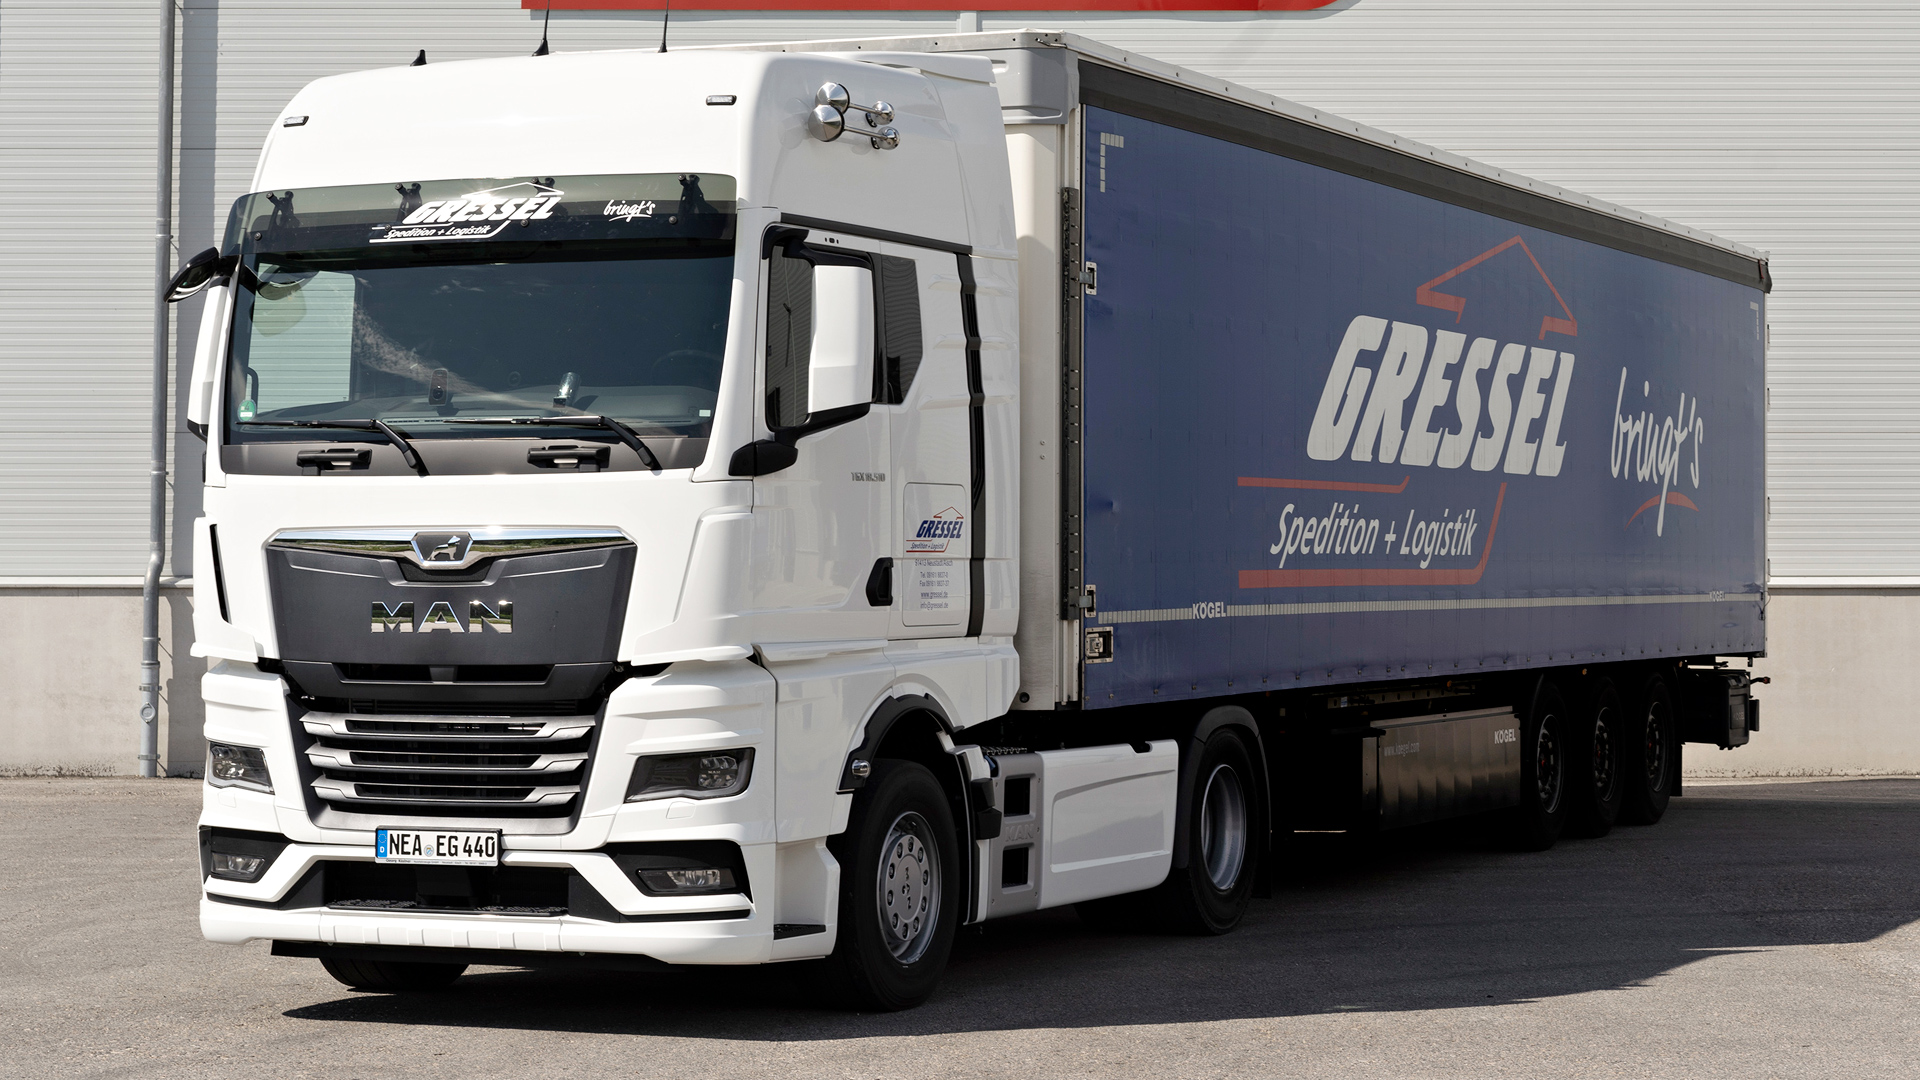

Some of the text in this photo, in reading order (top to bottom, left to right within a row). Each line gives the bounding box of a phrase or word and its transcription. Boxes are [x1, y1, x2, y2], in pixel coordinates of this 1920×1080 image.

[402, 196, 562, 225] GRESSEL
[603, 199, 656, 222] bringt's
[384, 225, 436, 240] Spedition
[446, 225, 491, 239] Logistik
[1306, 315, 1575, 477] GRESSEL
[1610, 366, 1703, 536] bringt's
[916, 519, 964, 539] GRESSEL
[1269, 502, 1478, 570] Spedition + Logistik
[920, 591, 949, 599] www.gressel.de
[920, 602, 949, 610] info@gressel.de
[371, 601, 513, 633] MAN
[1192, 601, 1226, 620] KÖGEL
[1494, 728, 1517, 744] KÖGEL
[389, 833, 496, 858] NEA EG 440
